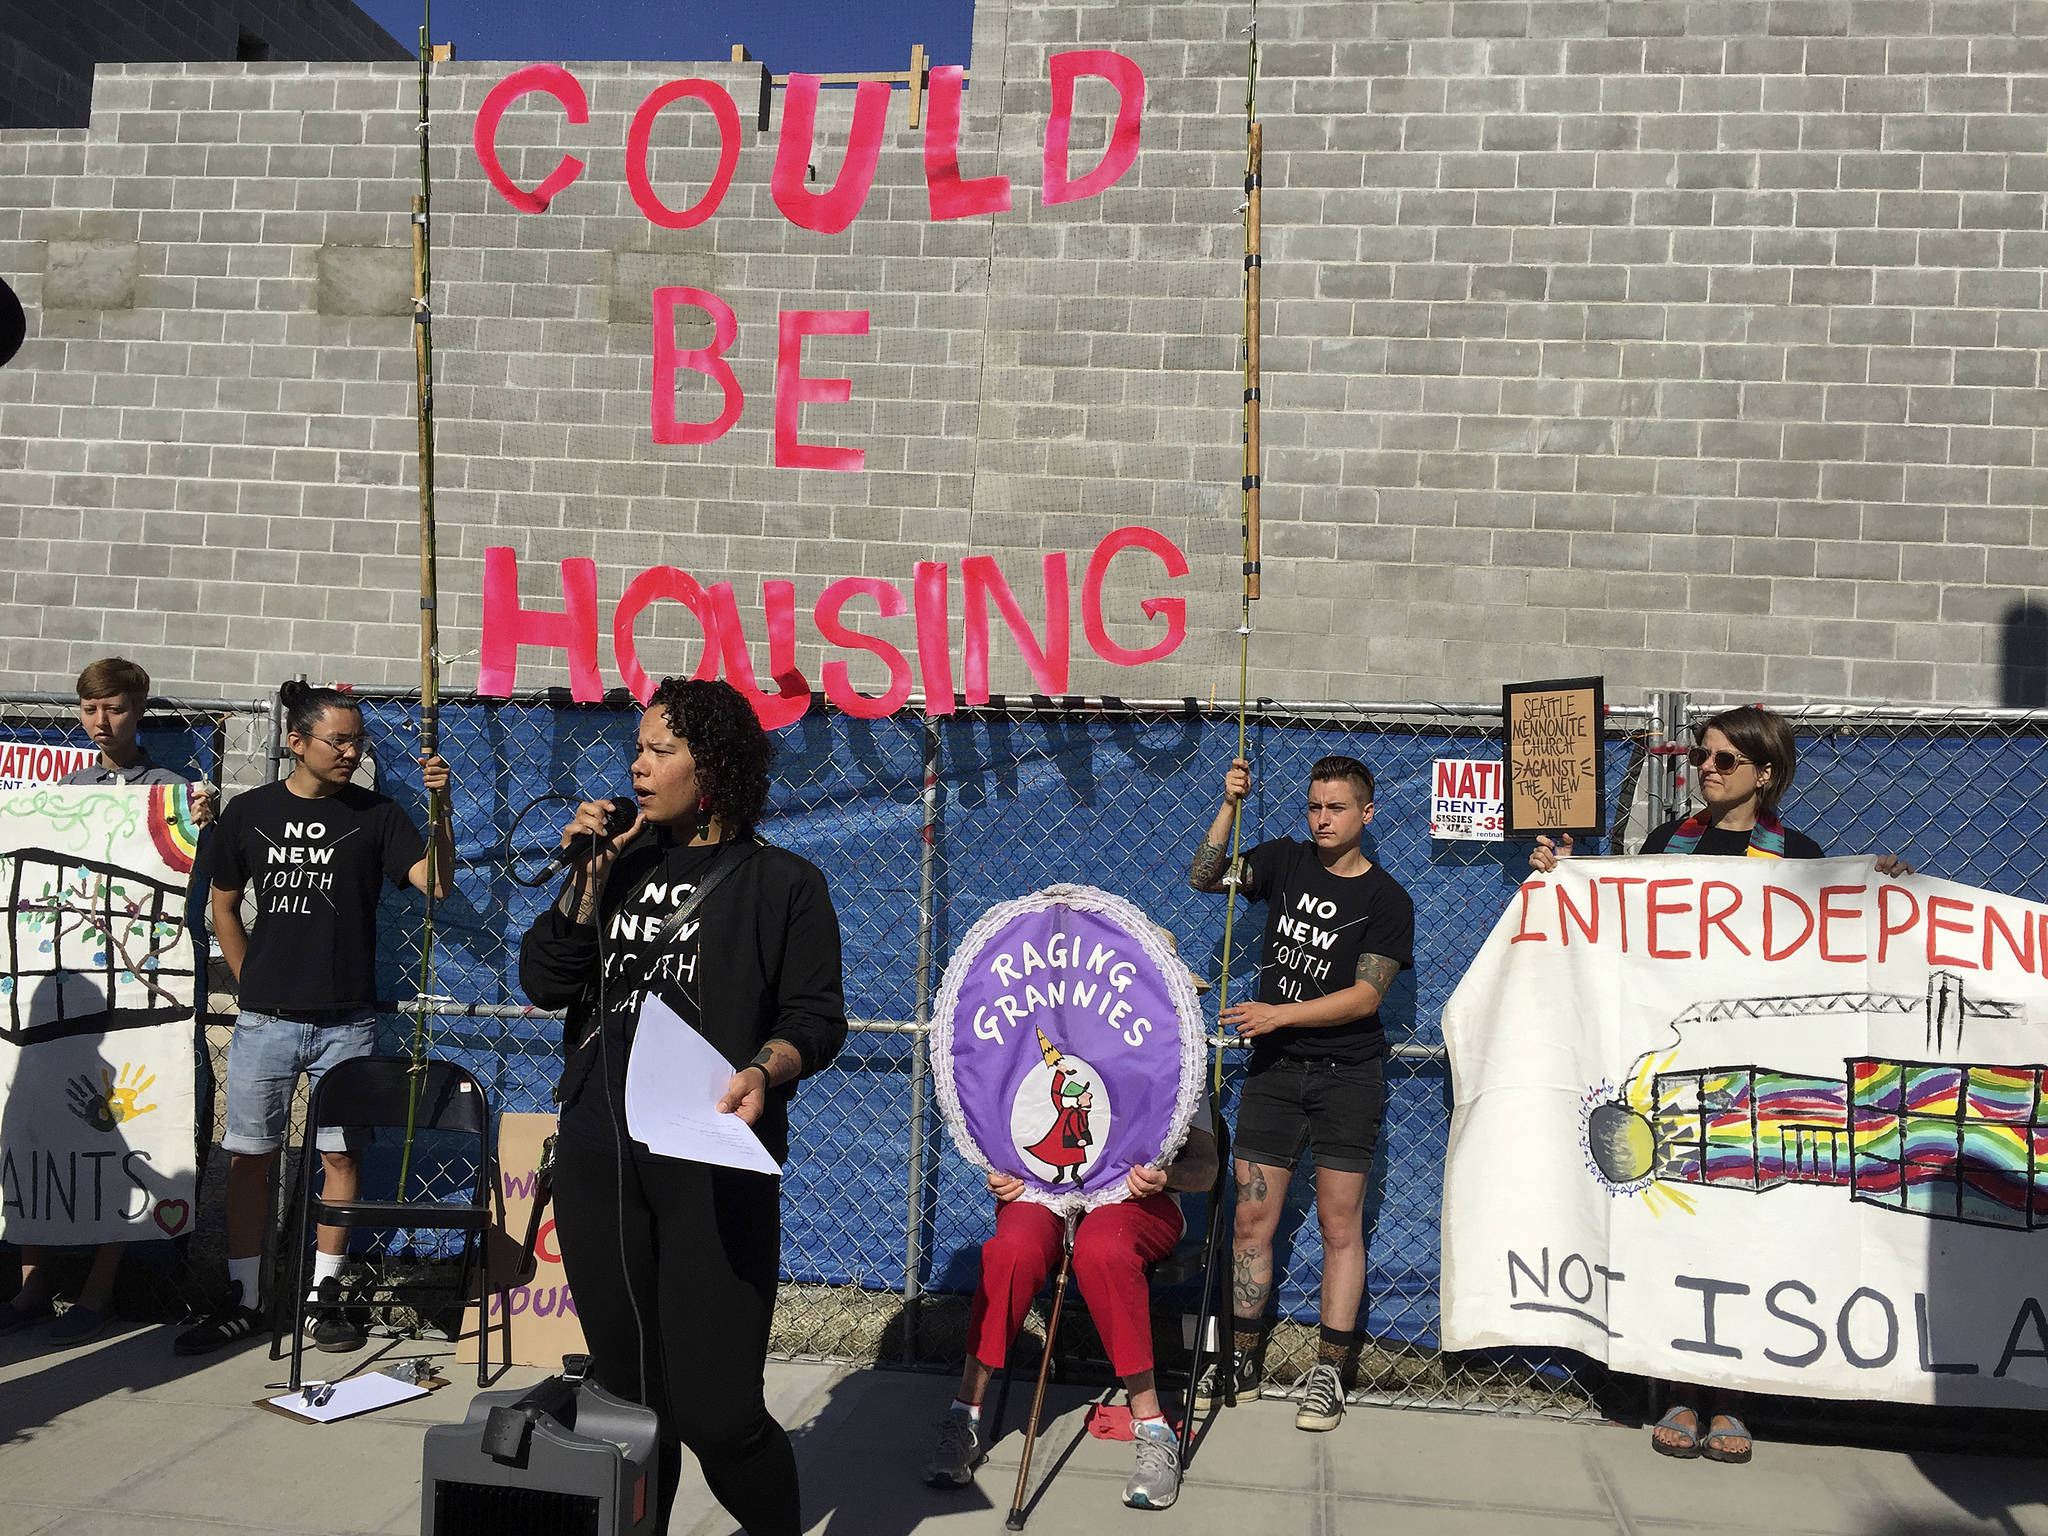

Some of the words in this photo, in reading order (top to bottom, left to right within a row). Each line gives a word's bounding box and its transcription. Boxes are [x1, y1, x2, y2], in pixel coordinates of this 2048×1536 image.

[474, 50, 1145, 234] COULD
[651, 286, 869, 472] BE
[477, 526, 1189, 731] HOUSING
[1524, 695, 1576, 720] SEATTLE
[1513, 715, 1587, 740] MENNONITE
[1523, 735, 1576, 757] CHURCH
[0, 745, 94, 782] ATIONA
[1523, 758, 1576, 778] AGAINST
[1516, 779, 1543, 796] THE
[1552, 776, 1580, 794] NEW
[1437, 800, 1504, 814] RENT-A
[1533, 792, 1572, 813] YOUTH
[1436, 815, 1473, 824] SISSIES
[1537, 810, 1567, 826] JAIL
[284, 822, 326, 839] NO
[267, 847, 334, 864] NEW
[262, 871, 333, 889] YOUTH
[269, 896, 311, 914] JAIL
[1297, 893, 1337, 919] NO
[1277, 915, 1338, 950] NEW
[991, 933, 1136, 993] RAGING
[973, 981, 1152, 1046] GRANNIES
[1508, 1247, 1625, 1316] NOT
